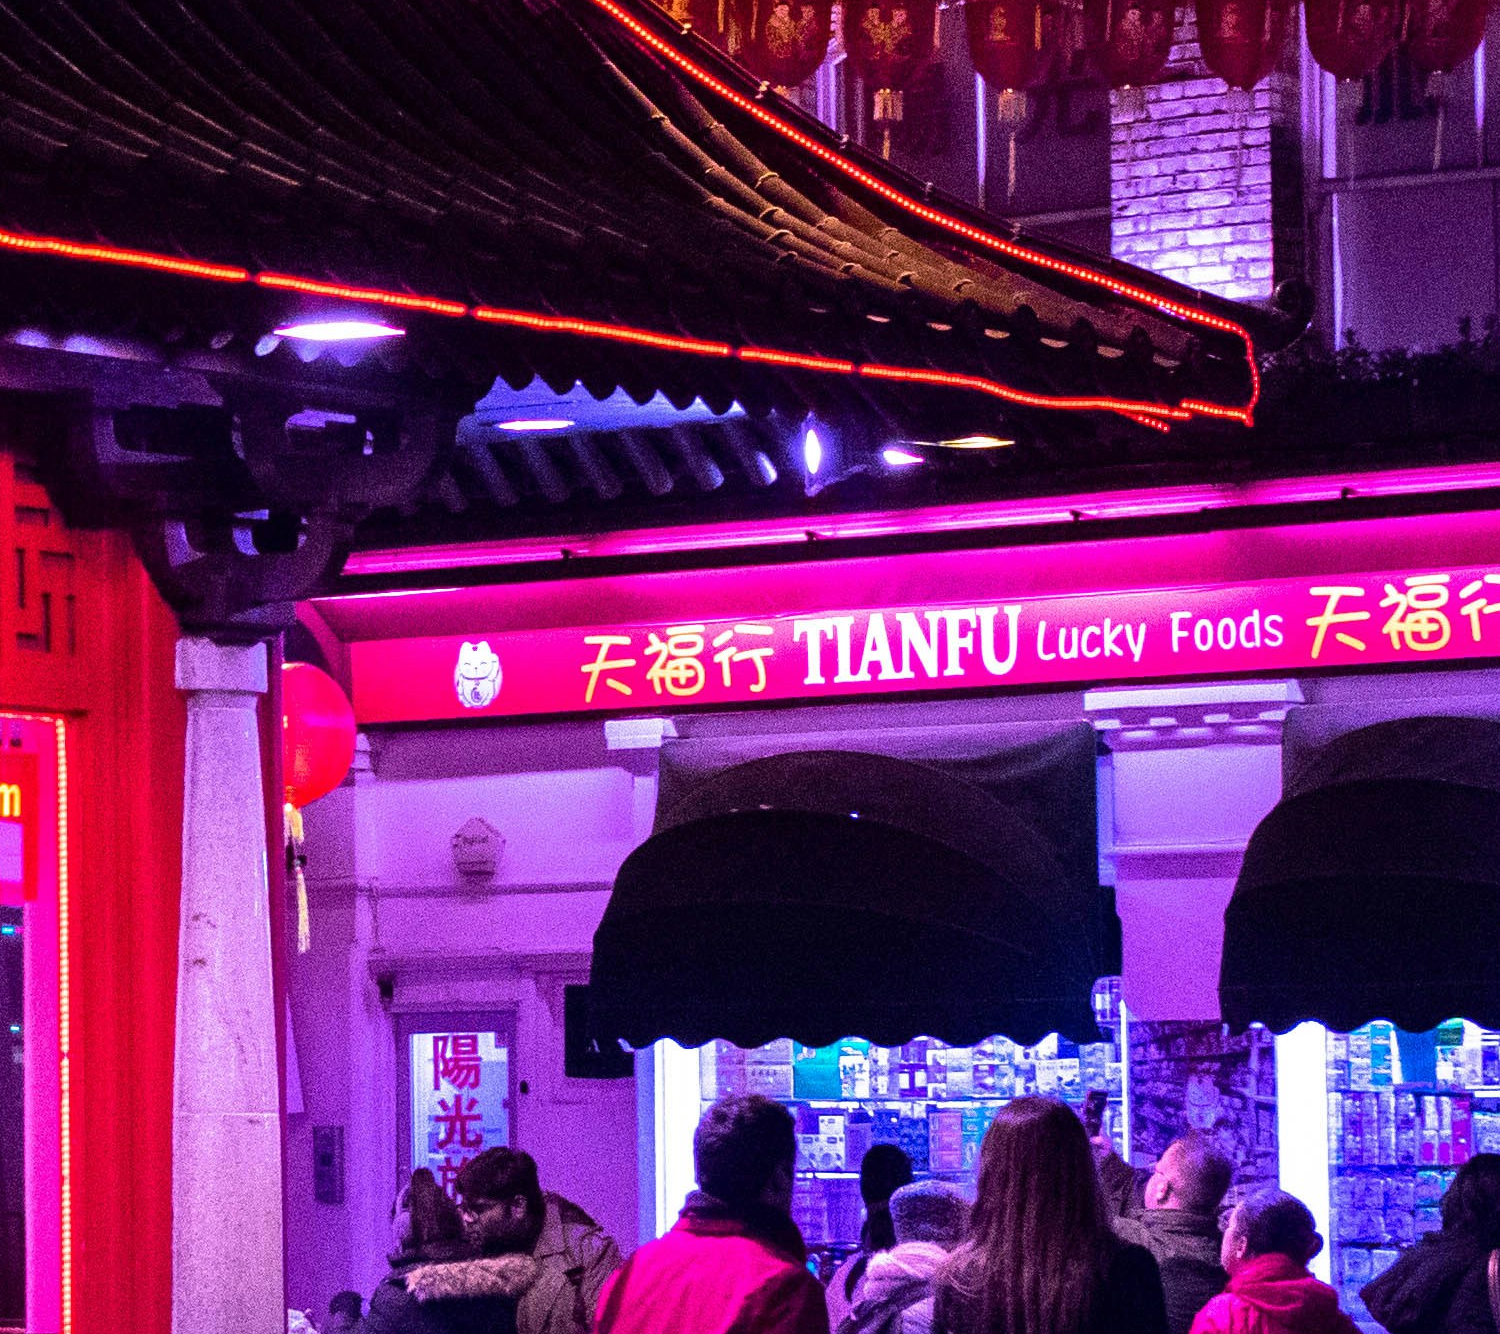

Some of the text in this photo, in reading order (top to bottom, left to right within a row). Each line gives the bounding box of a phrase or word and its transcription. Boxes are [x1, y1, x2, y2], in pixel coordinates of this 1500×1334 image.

[580, 623, 774, 704] 天福行
[793, 606, 1022, 686] TIANFU
[1037, 617, 1146, 662] Lucky
[1171, 609, 1285, 655] Foods
